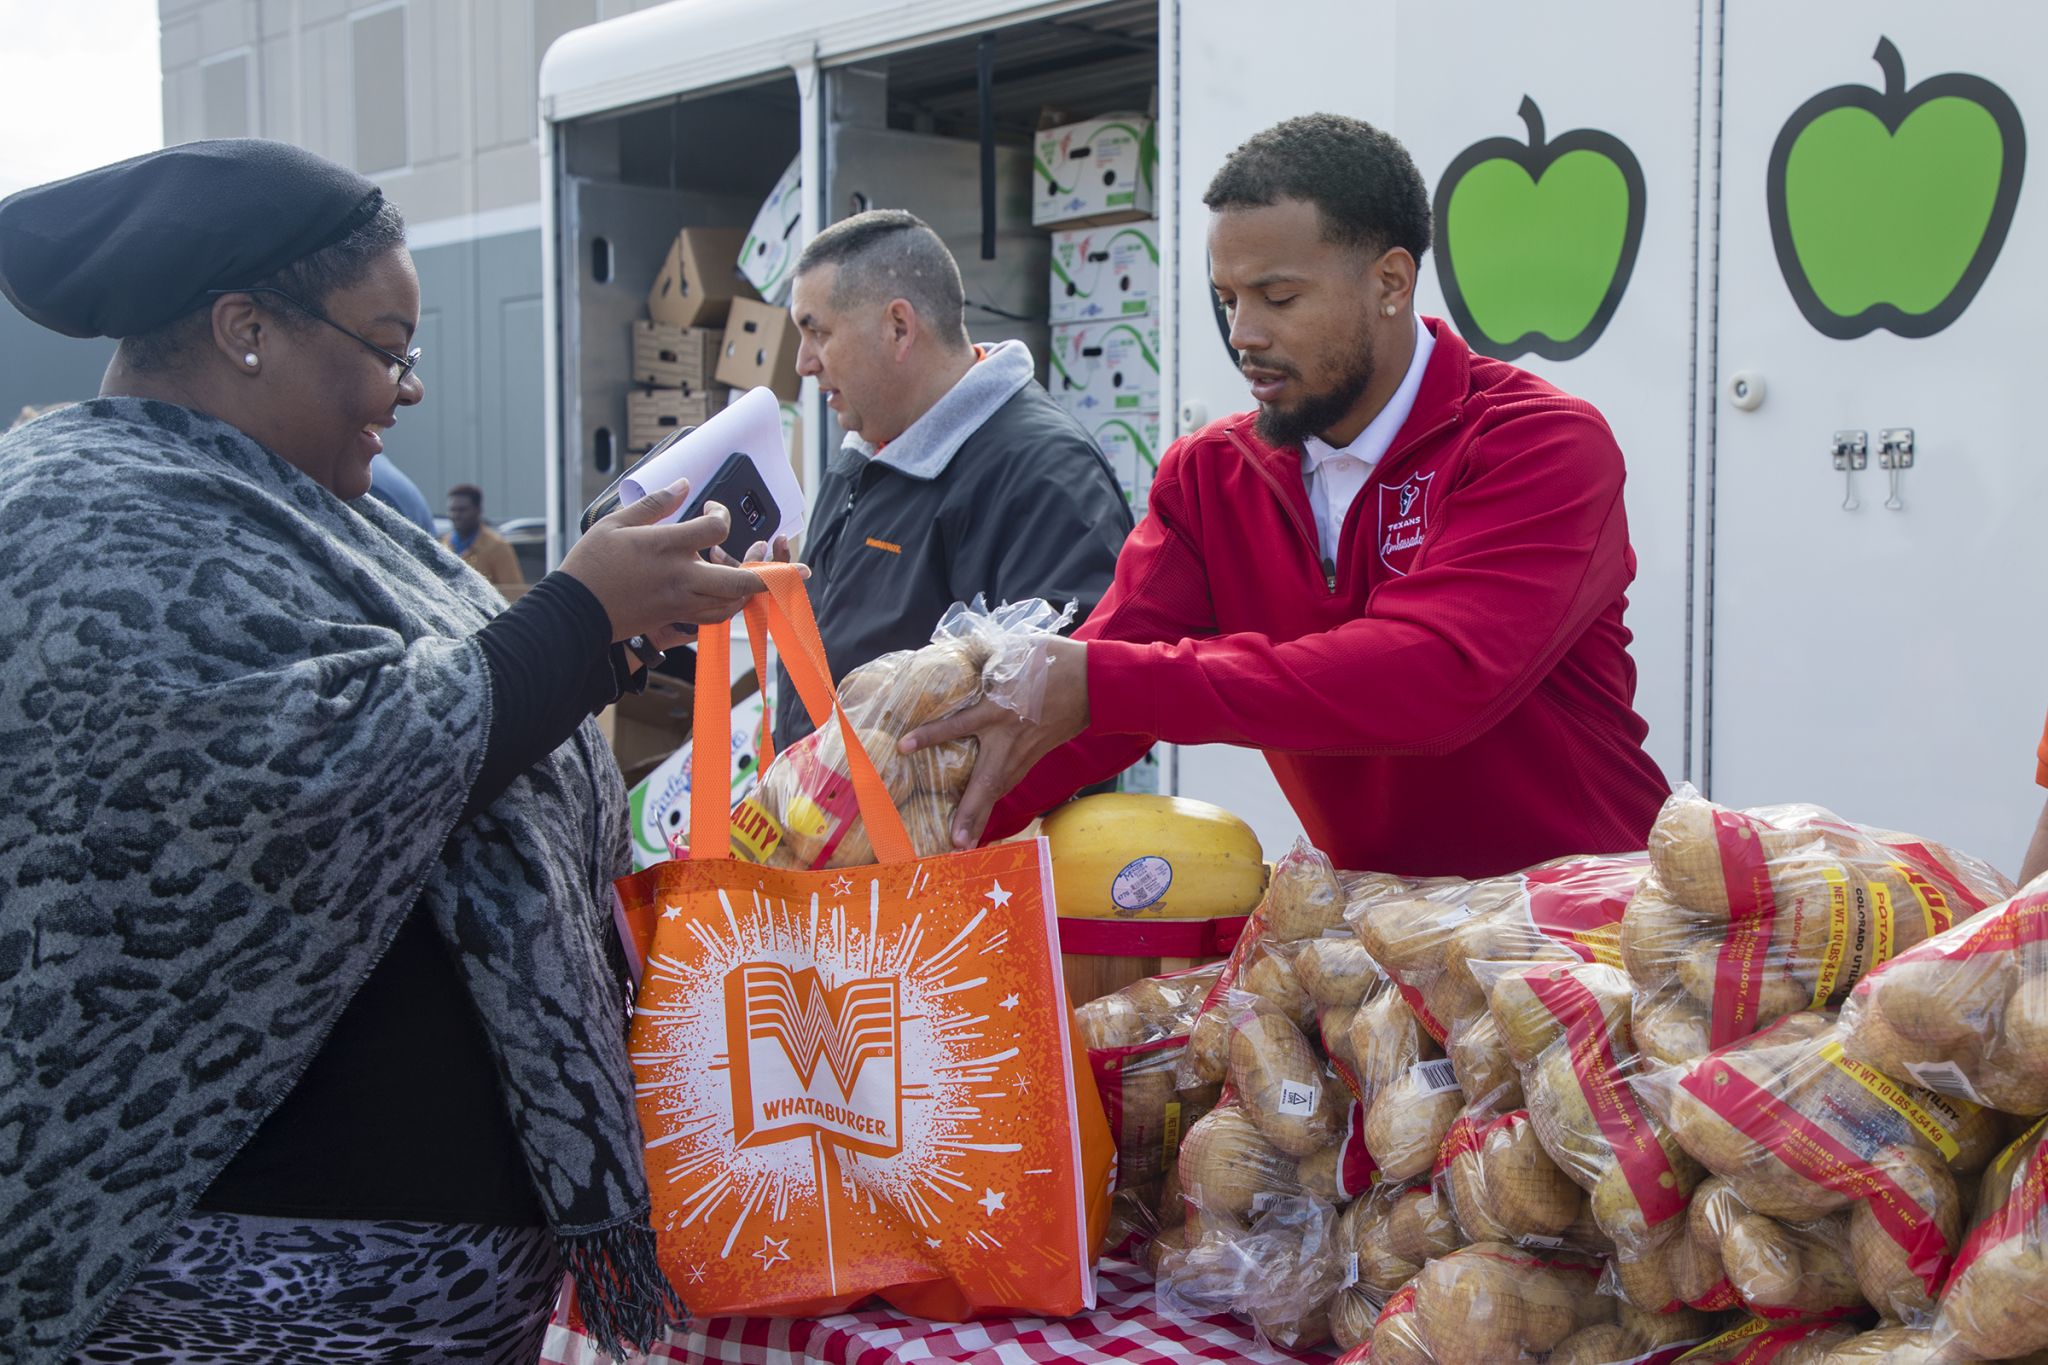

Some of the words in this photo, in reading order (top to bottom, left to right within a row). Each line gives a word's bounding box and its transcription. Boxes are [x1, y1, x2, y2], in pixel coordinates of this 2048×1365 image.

[1388, 516, 1421, 532] TEXANS
[730, 801, 778, 851] ALITY
[1833, 886, 1845, 906] NET
[1834, 908, 1845, 926] WT.
[1855, 888, 1866, 952] COLORADO
[1834, 928, 1844, 941] 10
[1876, 892, 1888, 966] POTAT
[1828, 943, 1842, 962] LBS
[1820, 963, 1836, 983] 4.54
[1735, 1003, 1744, 1024] INC.
[1840, 1057, 1862, 1072] NET
[1860, 1066, 1879, 1086] WT.
[1877, 1082, 1892, 1098] 10
[1889, 1091, 1911, 1110] LBS
[1910, 1107, 1931, 1128] 4.54
[762, 1097, 888, 1138] WHATABURGER
[1634, 1135, 1647, 1154] INC.
[1791, 1128, 1834, 1163] FARMING
[1898, 1209, 1918, 1230] INC.
